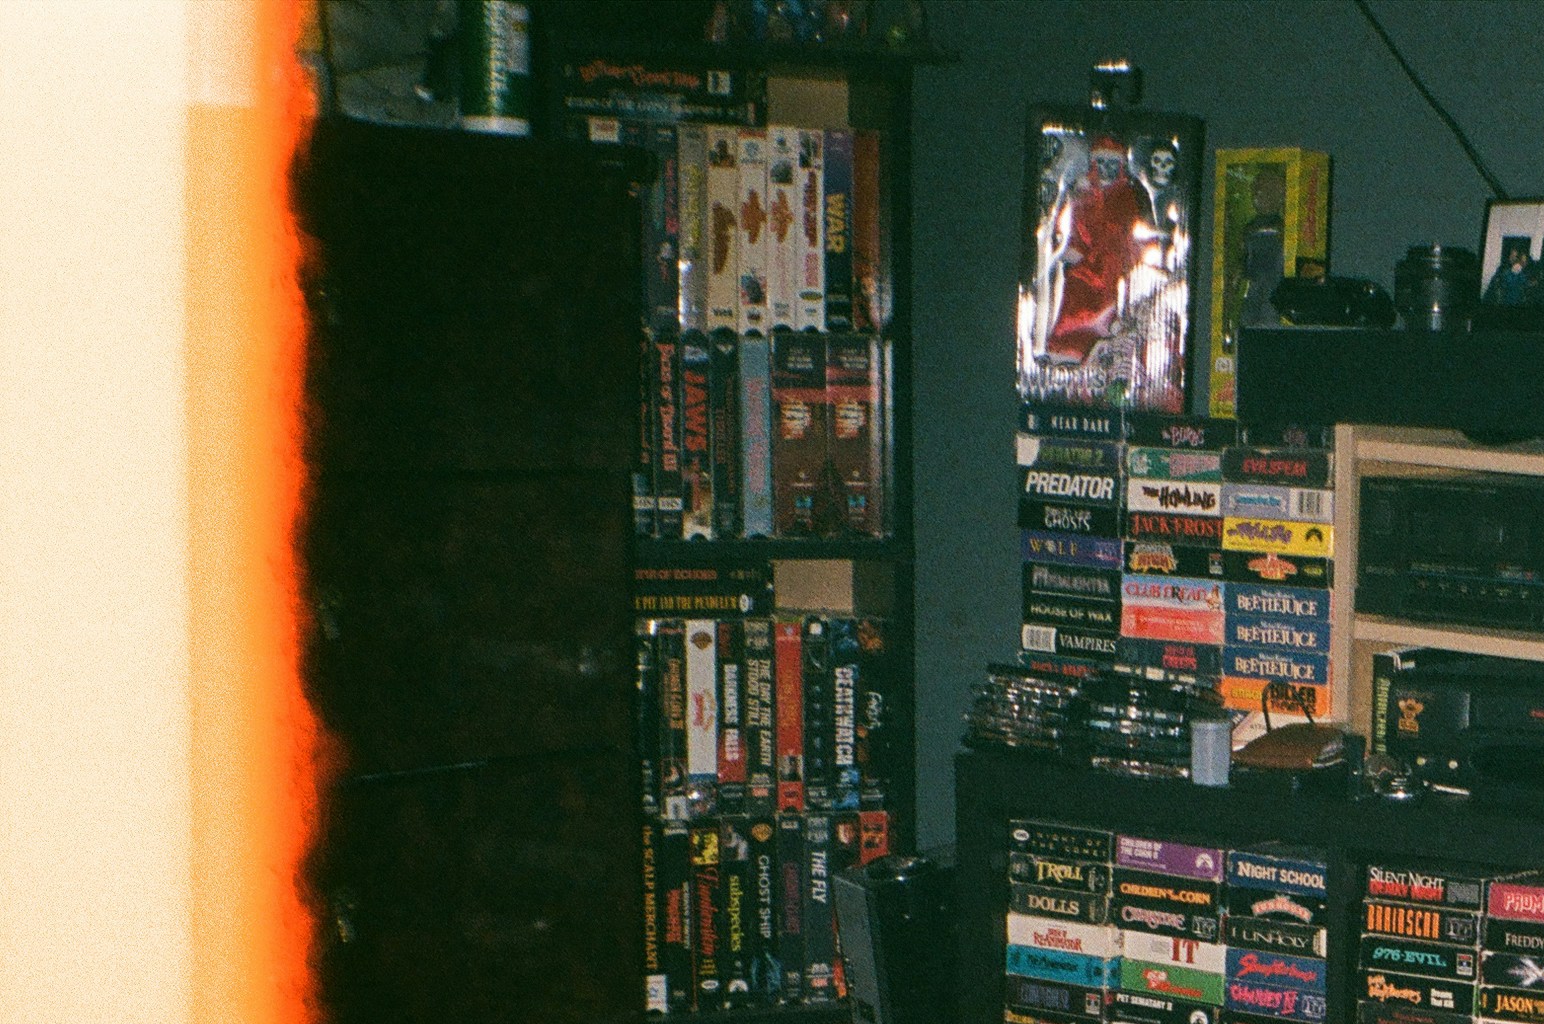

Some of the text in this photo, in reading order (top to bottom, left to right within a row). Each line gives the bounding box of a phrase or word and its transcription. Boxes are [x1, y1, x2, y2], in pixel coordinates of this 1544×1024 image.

[826, 193, 846, 253] WAR
[684, 371, 707, 452] JAWS
[1025, 472, 1114, 500] PREDATOR
[1158, 486, 1216, 510] HOWLING
[1237, 594, 1318, 617] BEETLEJUICE
[1059, 634, 1117, 653] VAMPIRES
[1236, 626, 1317, 648] BEETLEJUICE
[1235, 657, 1315, 680] BEETLEJUICE
[811, 850, 827, 904] THE FLY
[1237, 860, 1326, 890] NIGHT SCHOOL
[758, 855, 771, 939] GHOST SHIP
[1028, 893, 1080, 916] DOLLS
[730, 875, 745, 952] subspecies
[1171, 936, 1200, 965] IT
